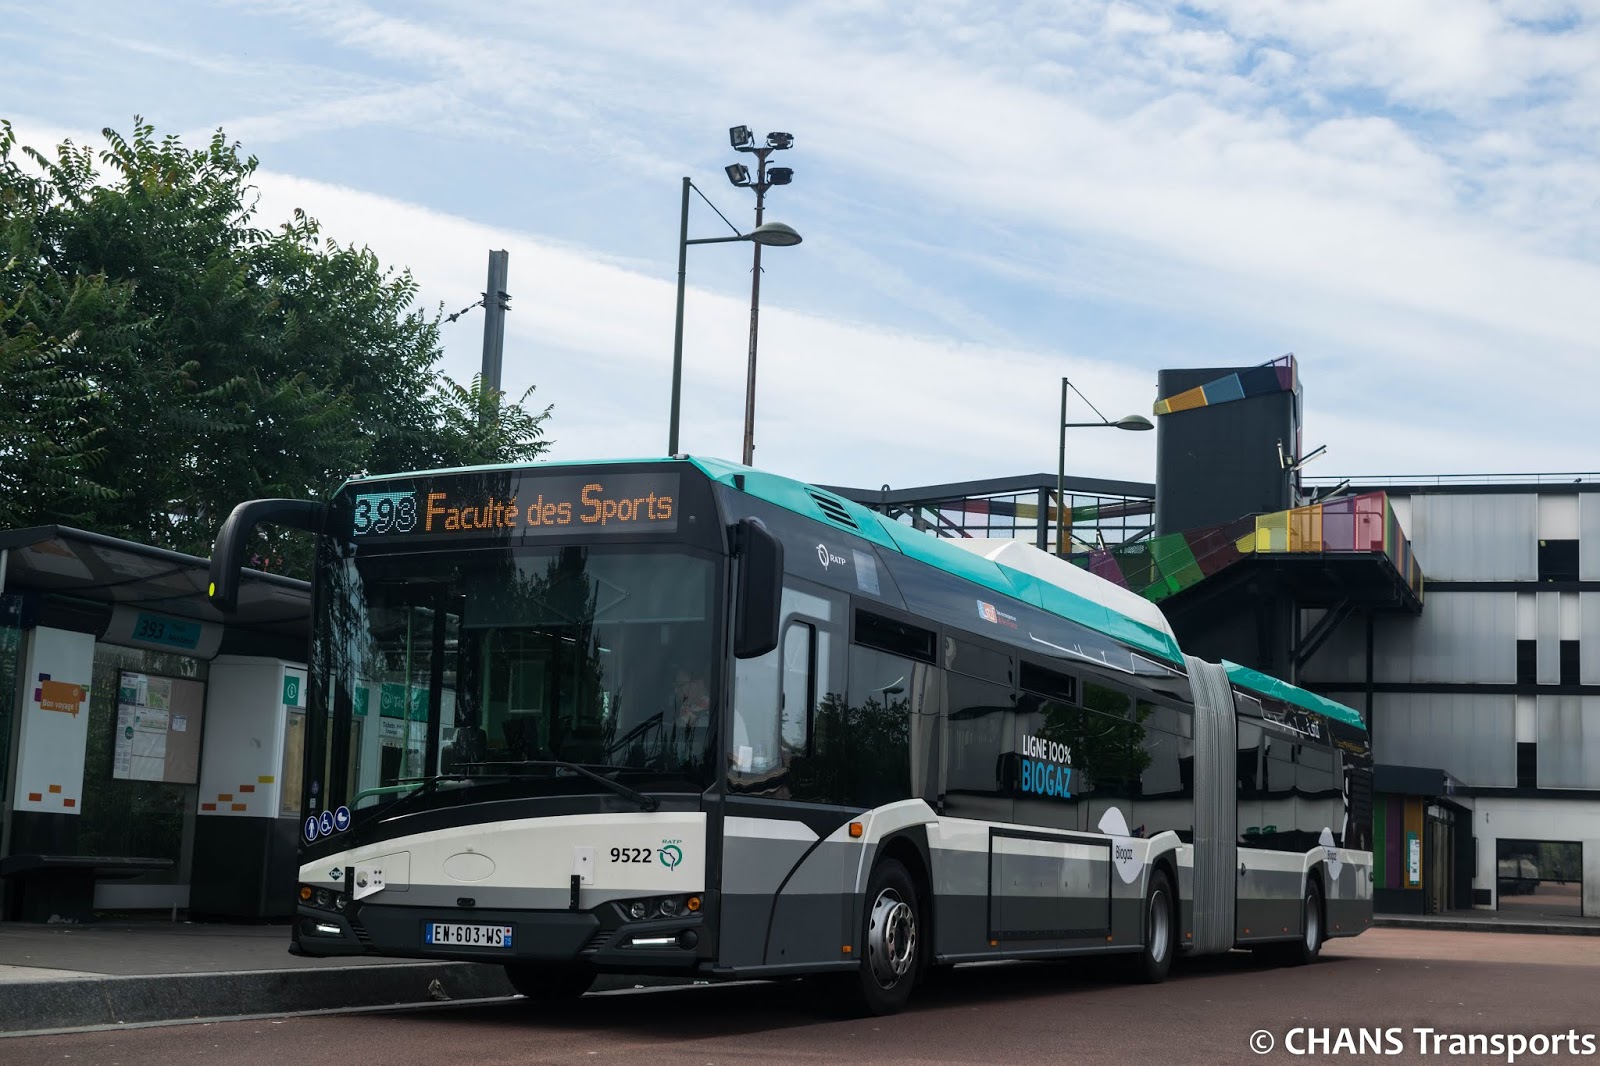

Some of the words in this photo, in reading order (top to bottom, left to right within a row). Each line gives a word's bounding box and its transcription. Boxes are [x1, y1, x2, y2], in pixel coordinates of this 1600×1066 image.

[353, 493, 418, 536] 393
[425, 492, 520, 532] Faculté
[527, 494, 572, 526] des
[580, 483, 673, 526] Sports
[830, 553, 846, 565] RATP
[138, 619, 165, 639] 393
[42, 699, 54, 708] Bon
[55, 702, 75, 712] voyage
[1022, 734, 1047, 759] LIGNE
[1048, 740, 1071, 764] 100%
[1022, 758, 1071, 798] BIOGAZ
[610, 847, 652, 863] 9522
[1116, 845, 1133, 864] Biogaz
